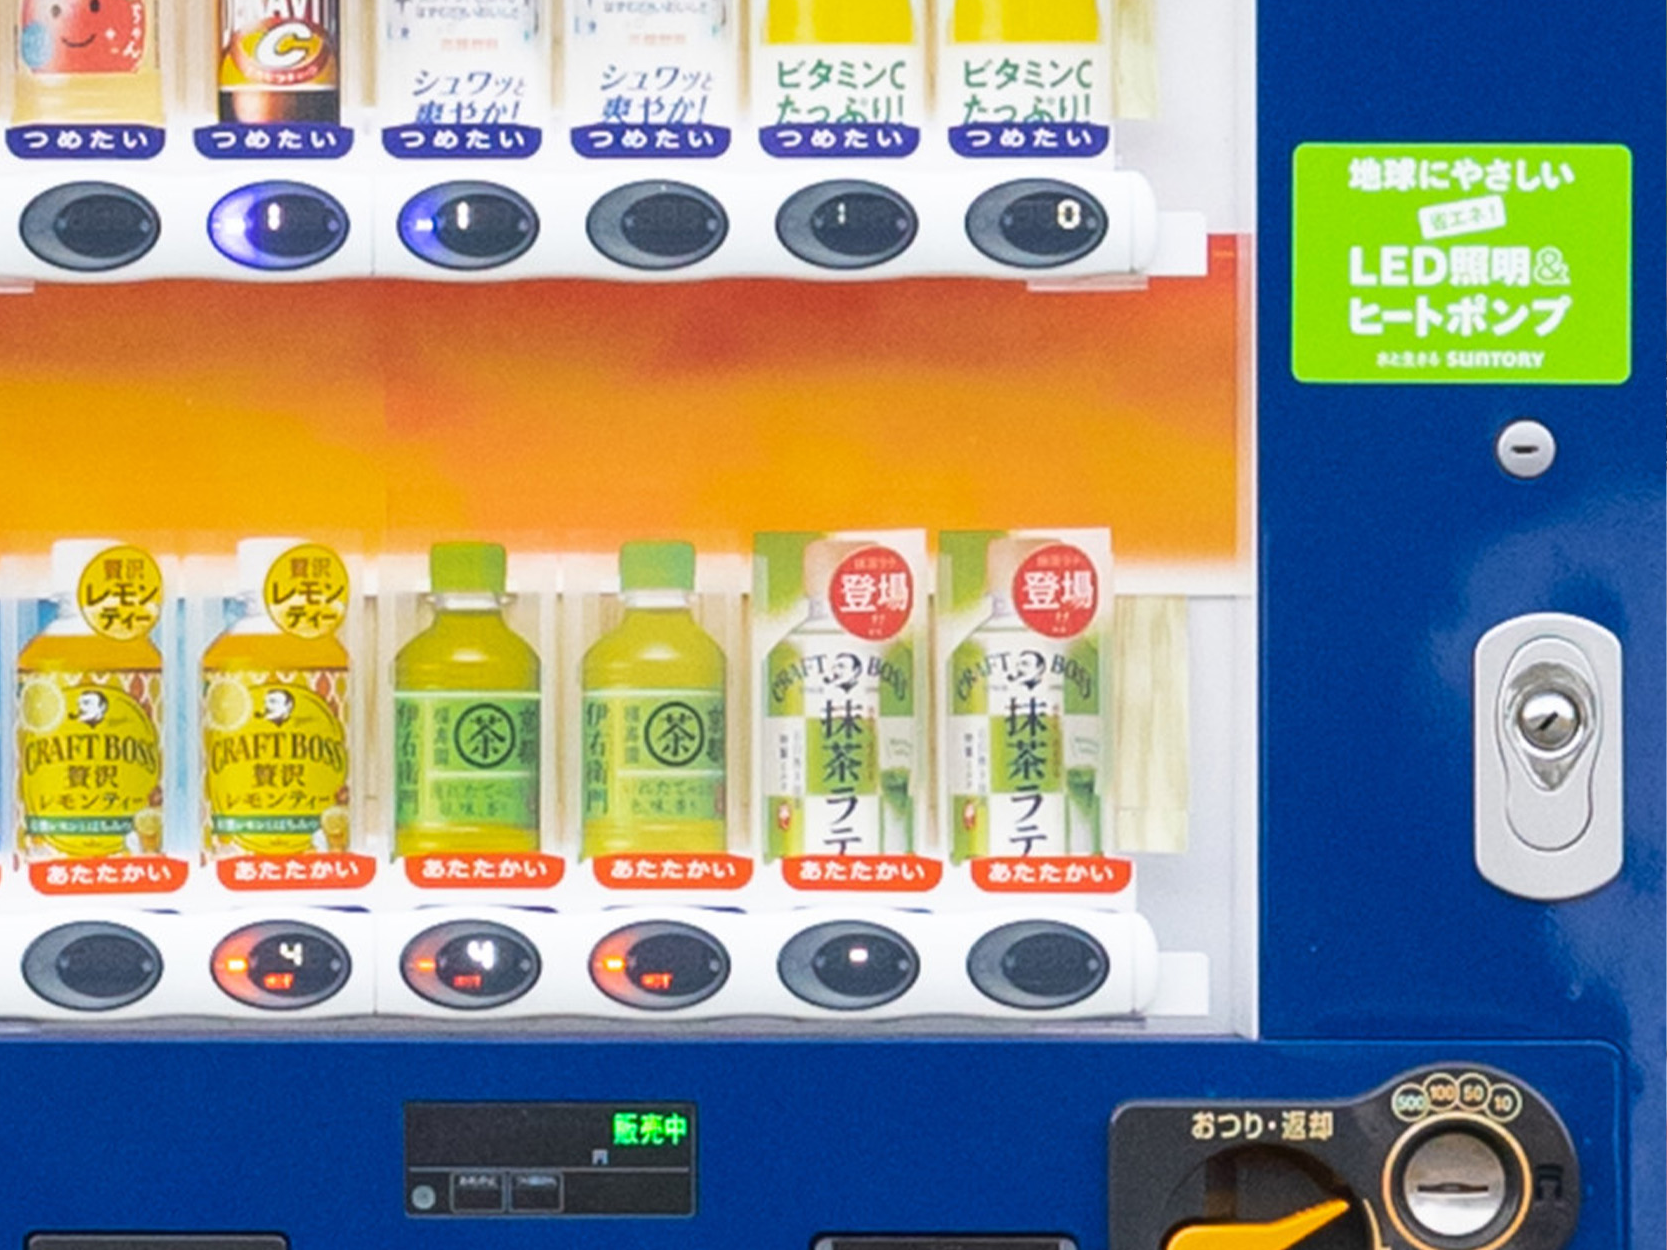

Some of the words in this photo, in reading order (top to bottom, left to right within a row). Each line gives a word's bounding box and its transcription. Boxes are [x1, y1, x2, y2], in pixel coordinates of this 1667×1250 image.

[413, 70, 527, 97] シュワッと
[600, 64, 713, 91] シュワッと
[777, 58, 907, 92] ビタミンC
[963, 58, 1093, 92] ビタミンC
[776, 94, 906, 125] たっぷり!
[962, 94, 1092, 125] たっぷり!
[23, 130, 148, 150] つめたい
[211, 129, 337, 149] つめたい
[399, 129, 526, 150] つめたい
[588, 129, 715, 149] つめたい
[776, 128, 903, 149] つめたい
[965, 128, 1093, 149] つめたい
[1347, 156, 1576, 193] 地球にやさしい
[1348, 245, 1572, 287] LED照明&
[1349, 292, 1573, 338] ヒートポンプ
[1446, 350, 1545, 369] SUNTORY
[103, 558, 146, 580] 贅沢
[289, 557, 332, 579] 贅沢
[85, 582, 159, 607] レモン
[271, 581, 345, 606] レモン
[839, 572, 910, 613] 登場
[1022, 571, 1094, 611] 登場
[100, 607, 151, 631] ティー
[286, 606, 337, 630] ティー
[772, 654, 827, 703] CRAFT
[866, 655, 908, 701] BOSS
[957, 653, 1010, 702] CRAFT
[1050, 656, 1092, 700] BOSS
[25, 734, 100, 775] CRAFT
[105, 733, 159, 774] BOSS
[211, 733, 286, 774] CRAFT
[291, 732, 345, 773] BOSS
[66, 765, 119, 789] 贅沢
[252, 764, 305, 788] 贅沢
[820, 699, 864, 856] 抹茶ラテ
[1004, 696, 1048, 856] 抹茶ラテ
[39, 792, 143, 811] レモンティー
[225, 791, 329, 810] レモンティー
[46, 863, 172, 885] あたたかい
[234, 859, 360, 881] あたたかい
[422, 857, 548, 879] あたたかい
[610, 857, 736, 879] あたたかい
[799, 858, 926, 881] あたたかい
[987, 861, 1114, 883] あたたかい
[1396, 1094, 1427, 1112] 500
[1430, 1084, 1456, 1102] 100
[1463, 1084, 1484, 1102] 50
[1494, 1094, 1513, 1112] 10
[612, 1112, 688, 1146] 販売中
[1190, 1111, 1335, 1141] おつり・返却
